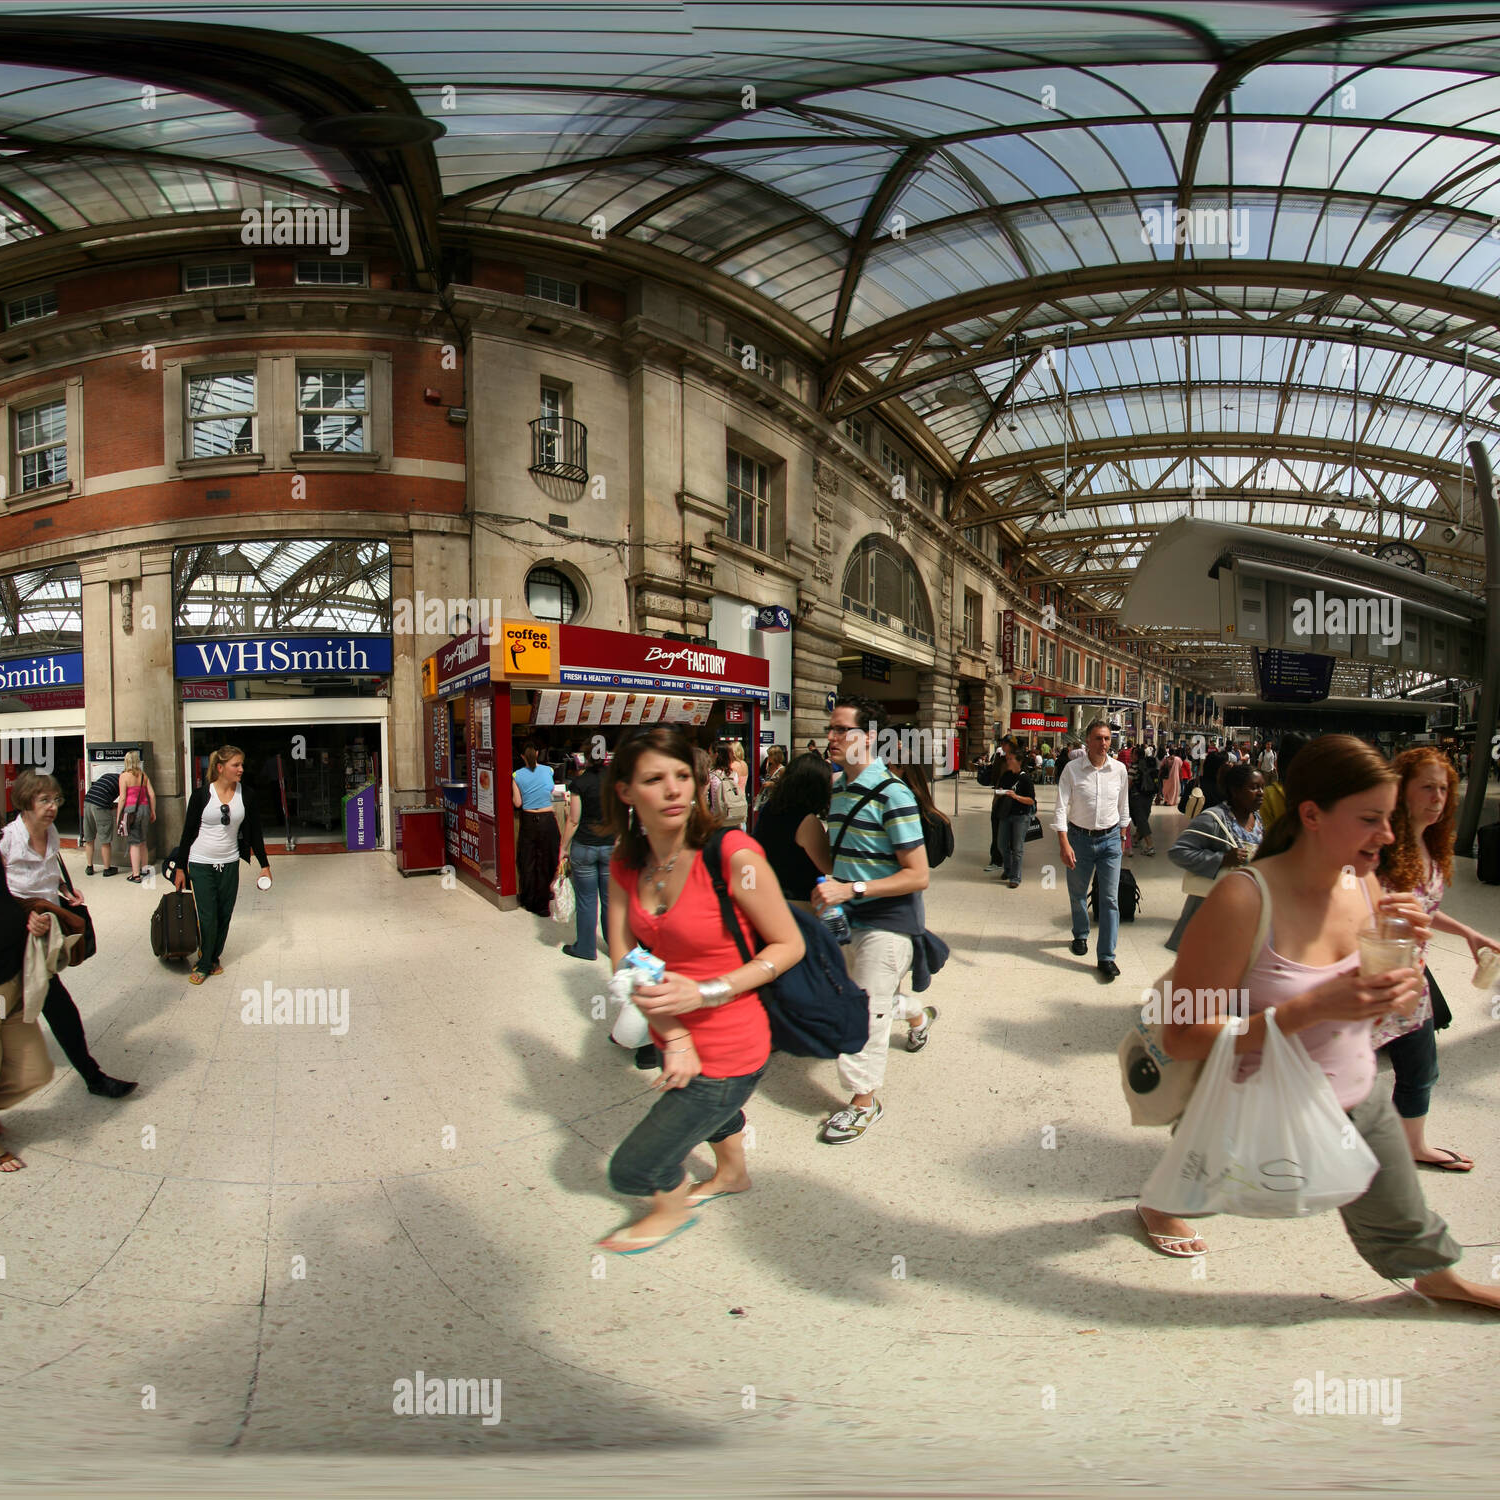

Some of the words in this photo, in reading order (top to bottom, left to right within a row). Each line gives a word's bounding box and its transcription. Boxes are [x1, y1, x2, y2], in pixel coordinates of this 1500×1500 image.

[507, 630, 547, 640] coffee
[533, 640, 550, 650] co.
[1004, 626, 1012, 670] COSTA
[196, 640, 370, 674] WHSmith
[644, 646, 688, 670] Bagel
[687, 651, 726, 676] FACTORY
[564, 673, 581, 681] FRESH
[588, 674, 611, 682] HEALTHY
[358, 797, 364, 806] CD
[461, 840, 474, 859] SALT
[474, 848, 479, 863] &
